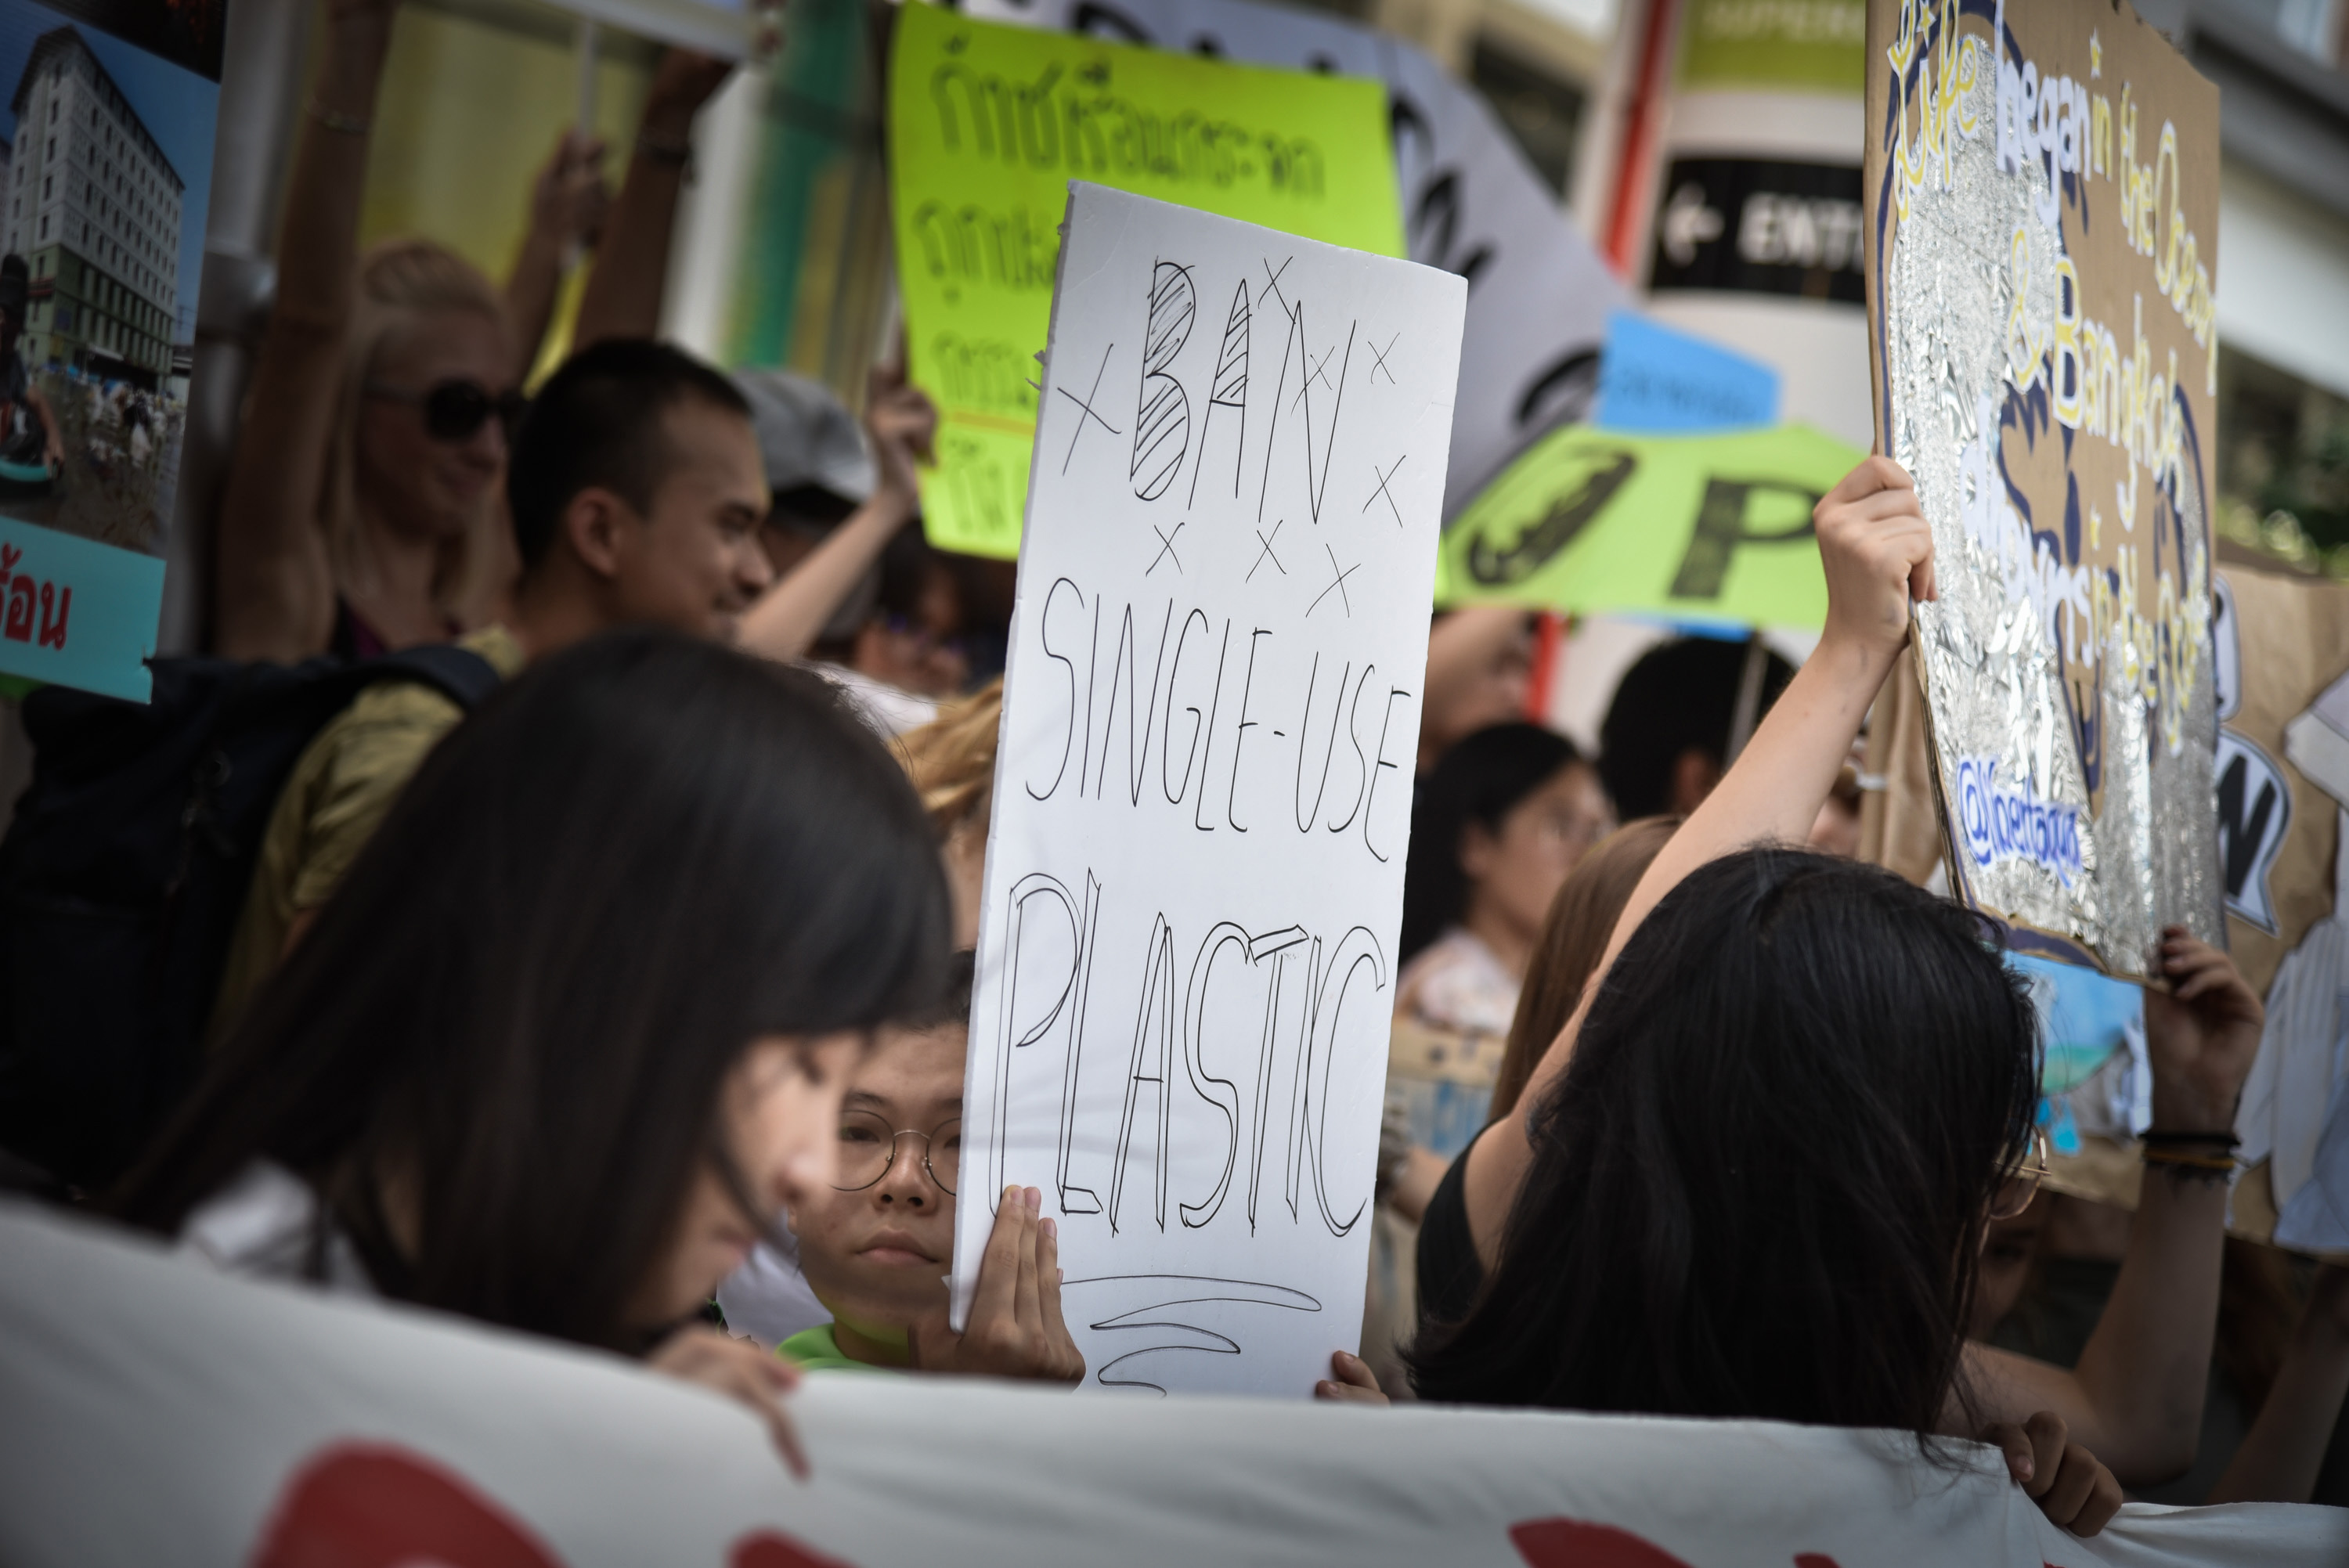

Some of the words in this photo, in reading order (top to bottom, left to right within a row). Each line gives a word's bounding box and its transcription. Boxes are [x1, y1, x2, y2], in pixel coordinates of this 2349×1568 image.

[1995, 0, 2091, 229] began
[2091, 28, 2112, 182] in
[2120, 81, 2154, 257] the
[1130, 255, 1356, 524] BAN
[2007, 225, 2049, 391] &
[989, 867, 1386, 1237] PLASTIC
